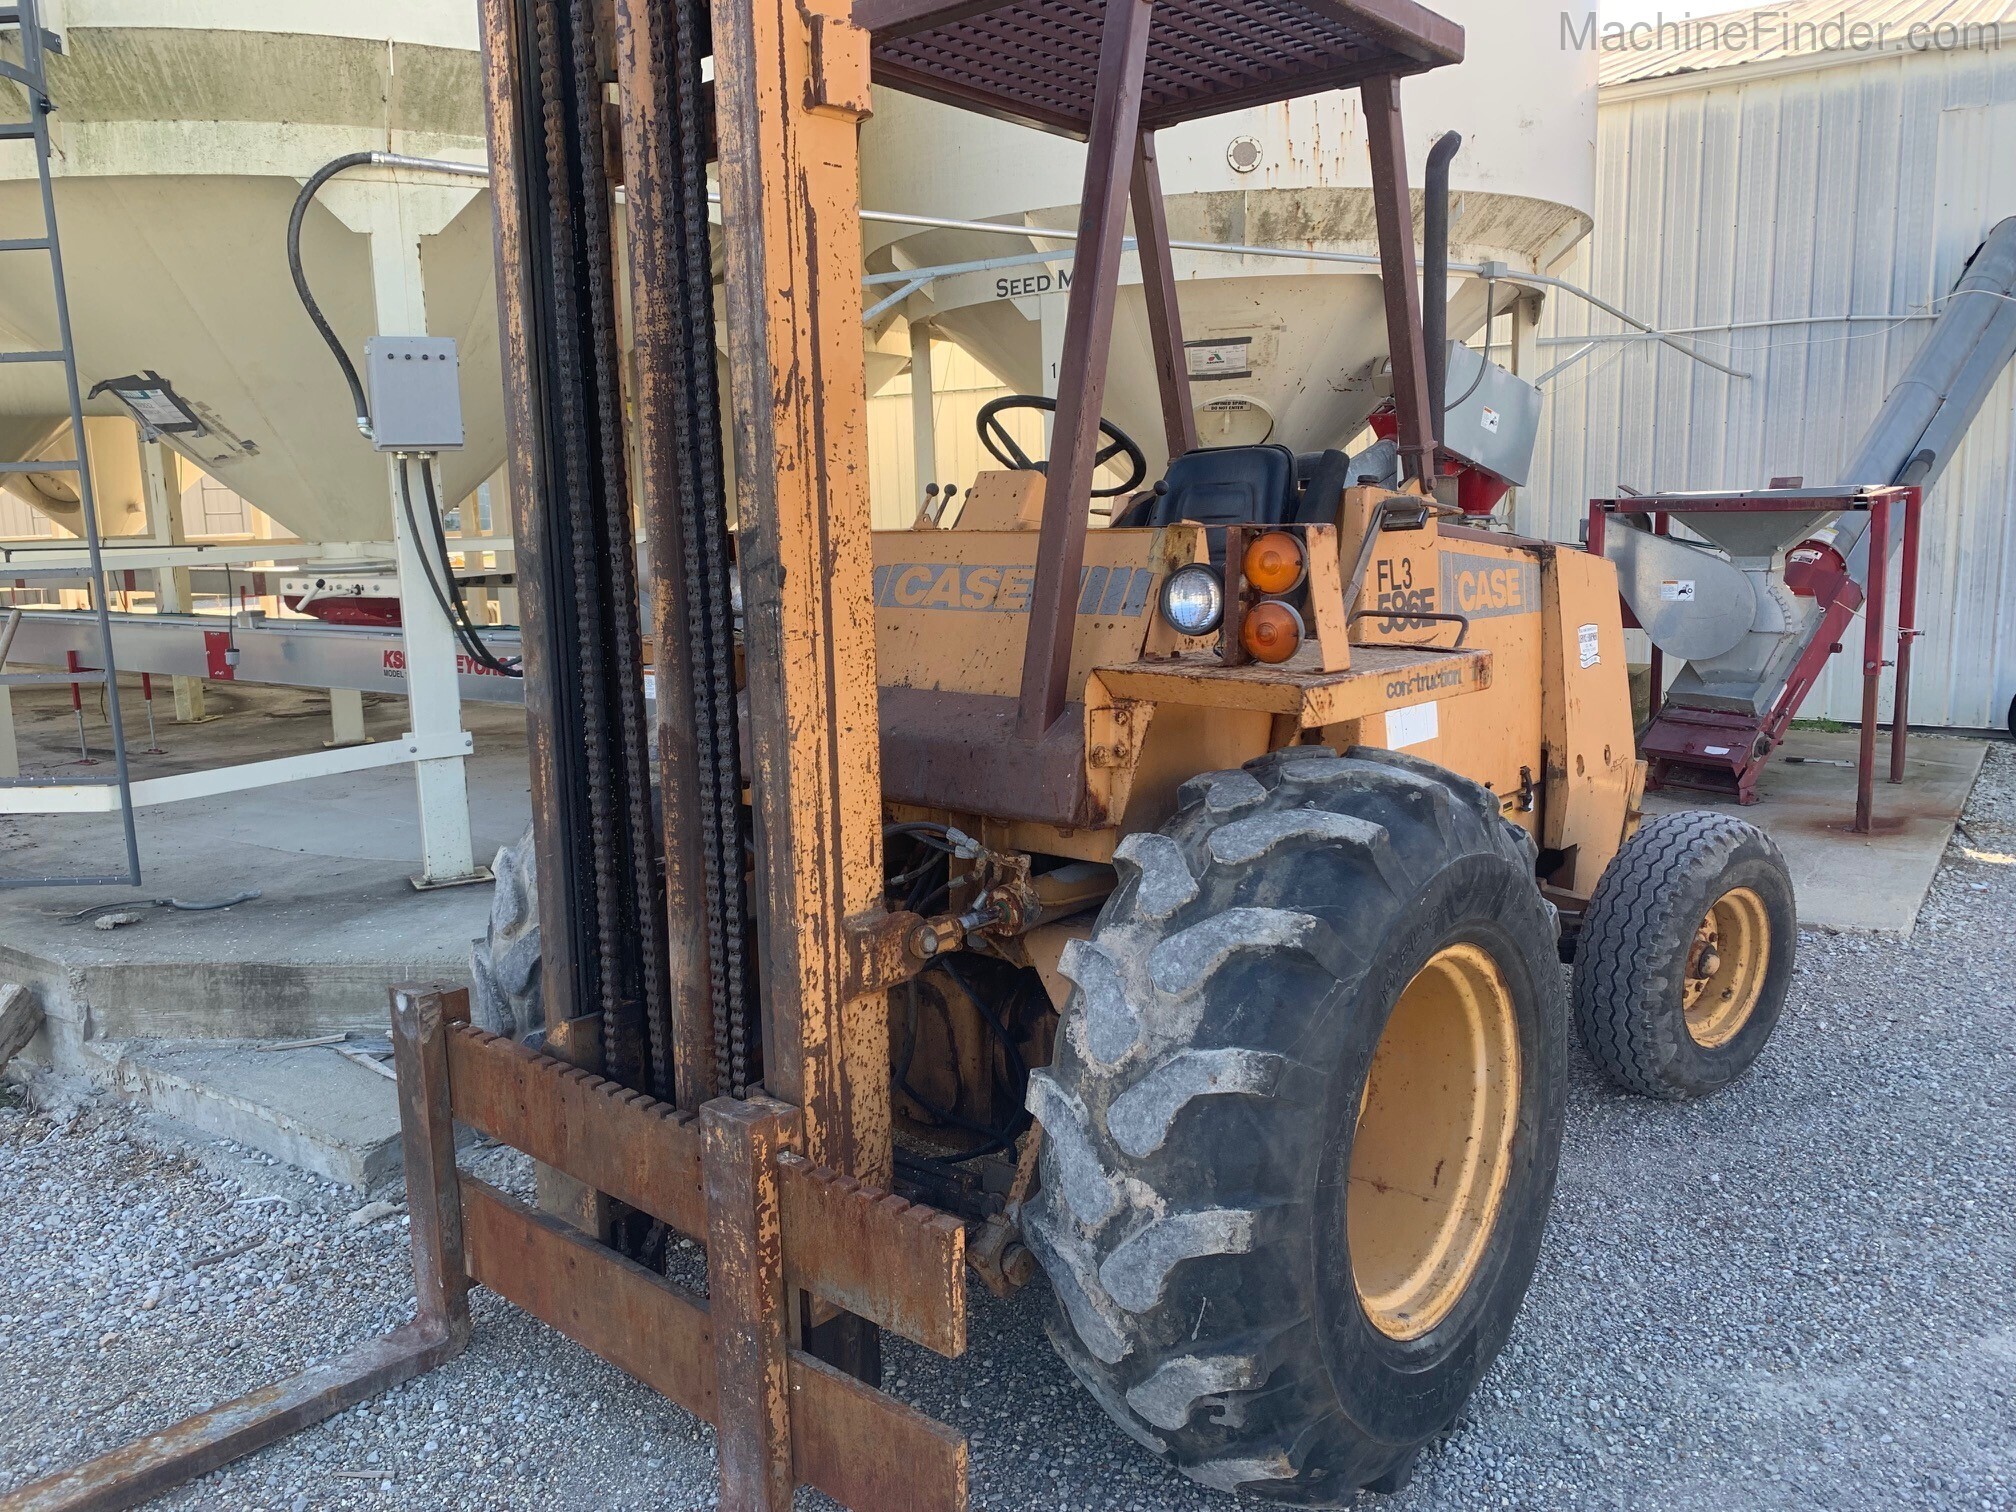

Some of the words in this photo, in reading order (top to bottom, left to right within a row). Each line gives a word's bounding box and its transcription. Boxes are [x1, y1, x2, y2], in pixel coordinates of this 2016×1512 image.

[996, 274, 1051, 298] SEED
[894, 566, 1036, 609] CASE
[1377, 557, 1412, 592] FL3
[1458, 568, 1521, 612] CASE
[1377, 587, 1437, 634] 586E
[384, 669, 404, 678] MODEL
